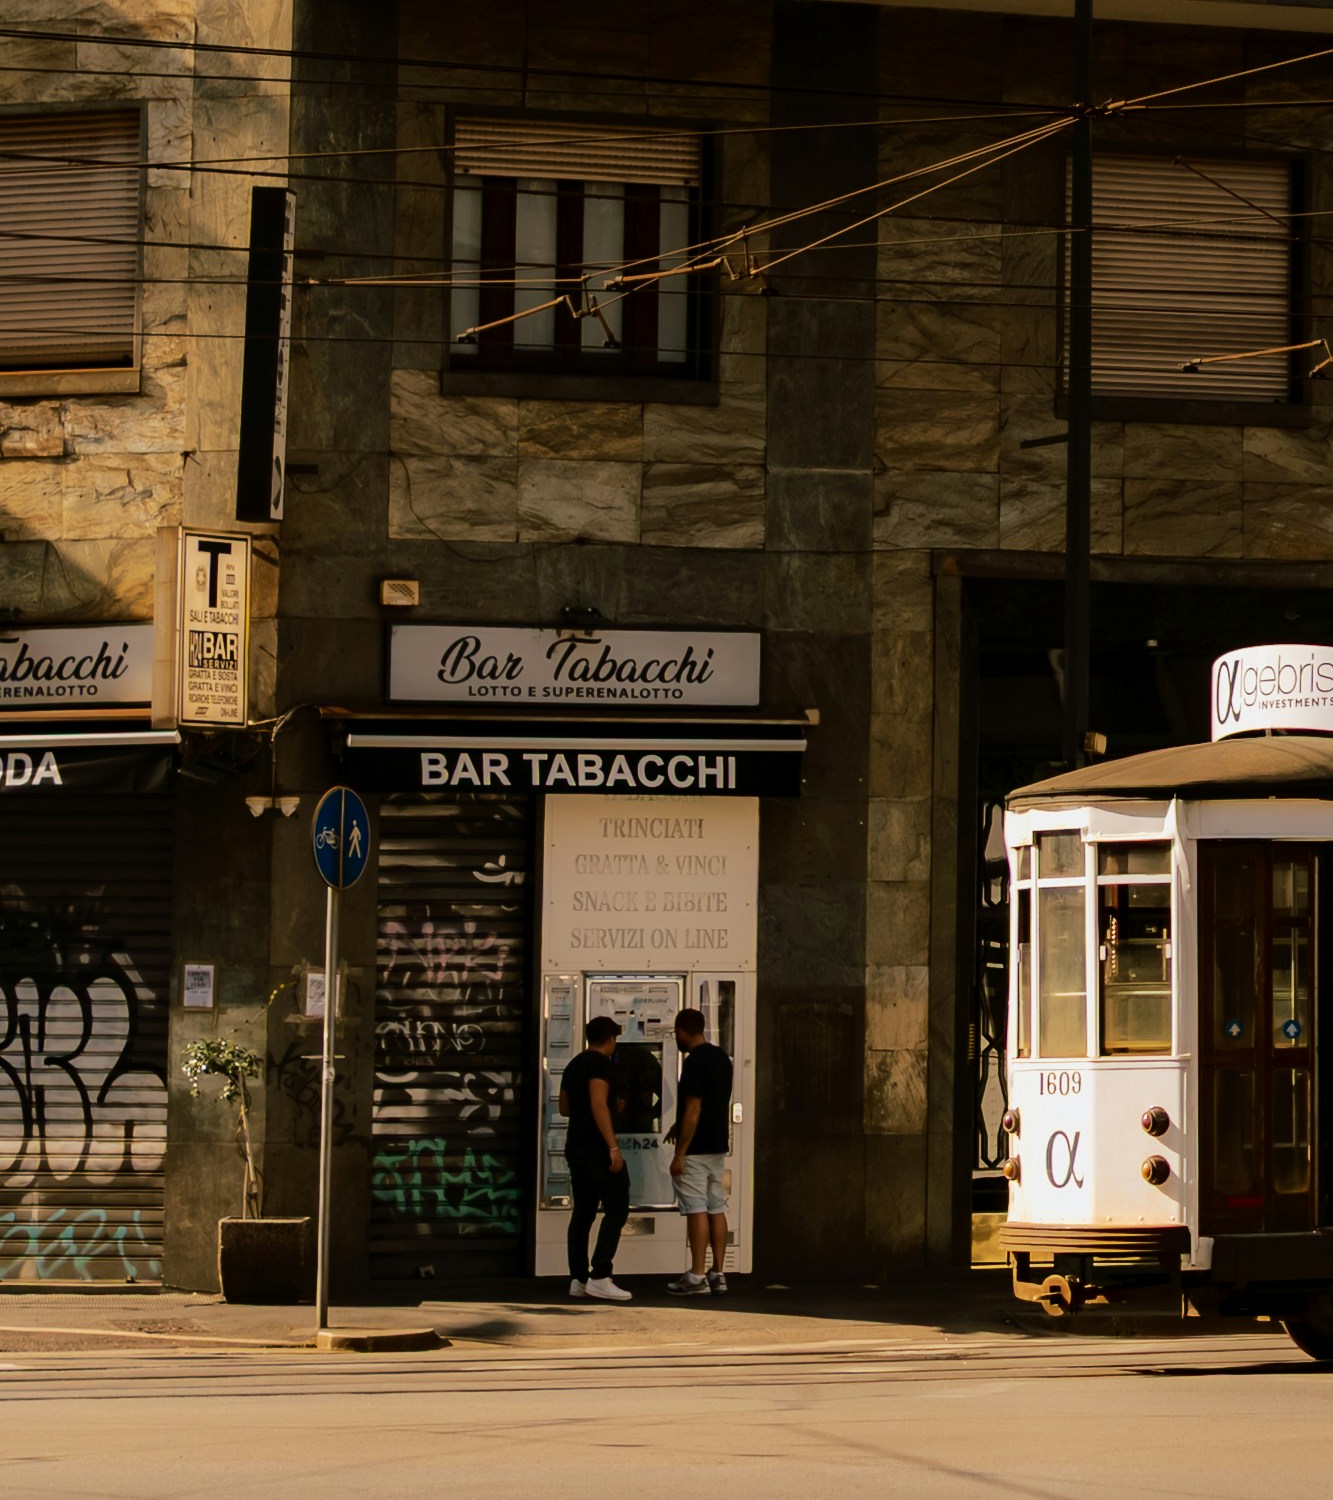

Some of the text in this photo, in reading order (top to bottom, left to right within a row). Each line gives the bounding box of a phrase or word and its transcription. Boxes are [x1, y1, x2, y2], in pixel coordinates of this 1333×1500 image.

[198, 540, 231, 608] T
[190, 609, 239, 625] SALI E TABACCHI
[203, 632, 238, 660] BAR
[203, 659, 238, 669] SERVIZI
[438, 635, 715, 684] Bar Tabacchi
[189, 669, 238, 681] GRATTA E SOSTA
[189, 681, 238, 693] GRATTA E VINCI
[468, 685, 684, 699] LOTTO E SUPERENALOTTO
[0, 751, 63, 786] DA
[420, 752, 737, 789] BAR TABACCHI
[599, 817, 704, 838] TRINCIATI
[574, 853, 728, 875] GRATTA & VINCI
[572, 890, 728, 912] SNACK E BIBITE
[570, 928, 728, 949] SERVIZI ON LINE
[1040, 1071, 1082, 1096] 1609
